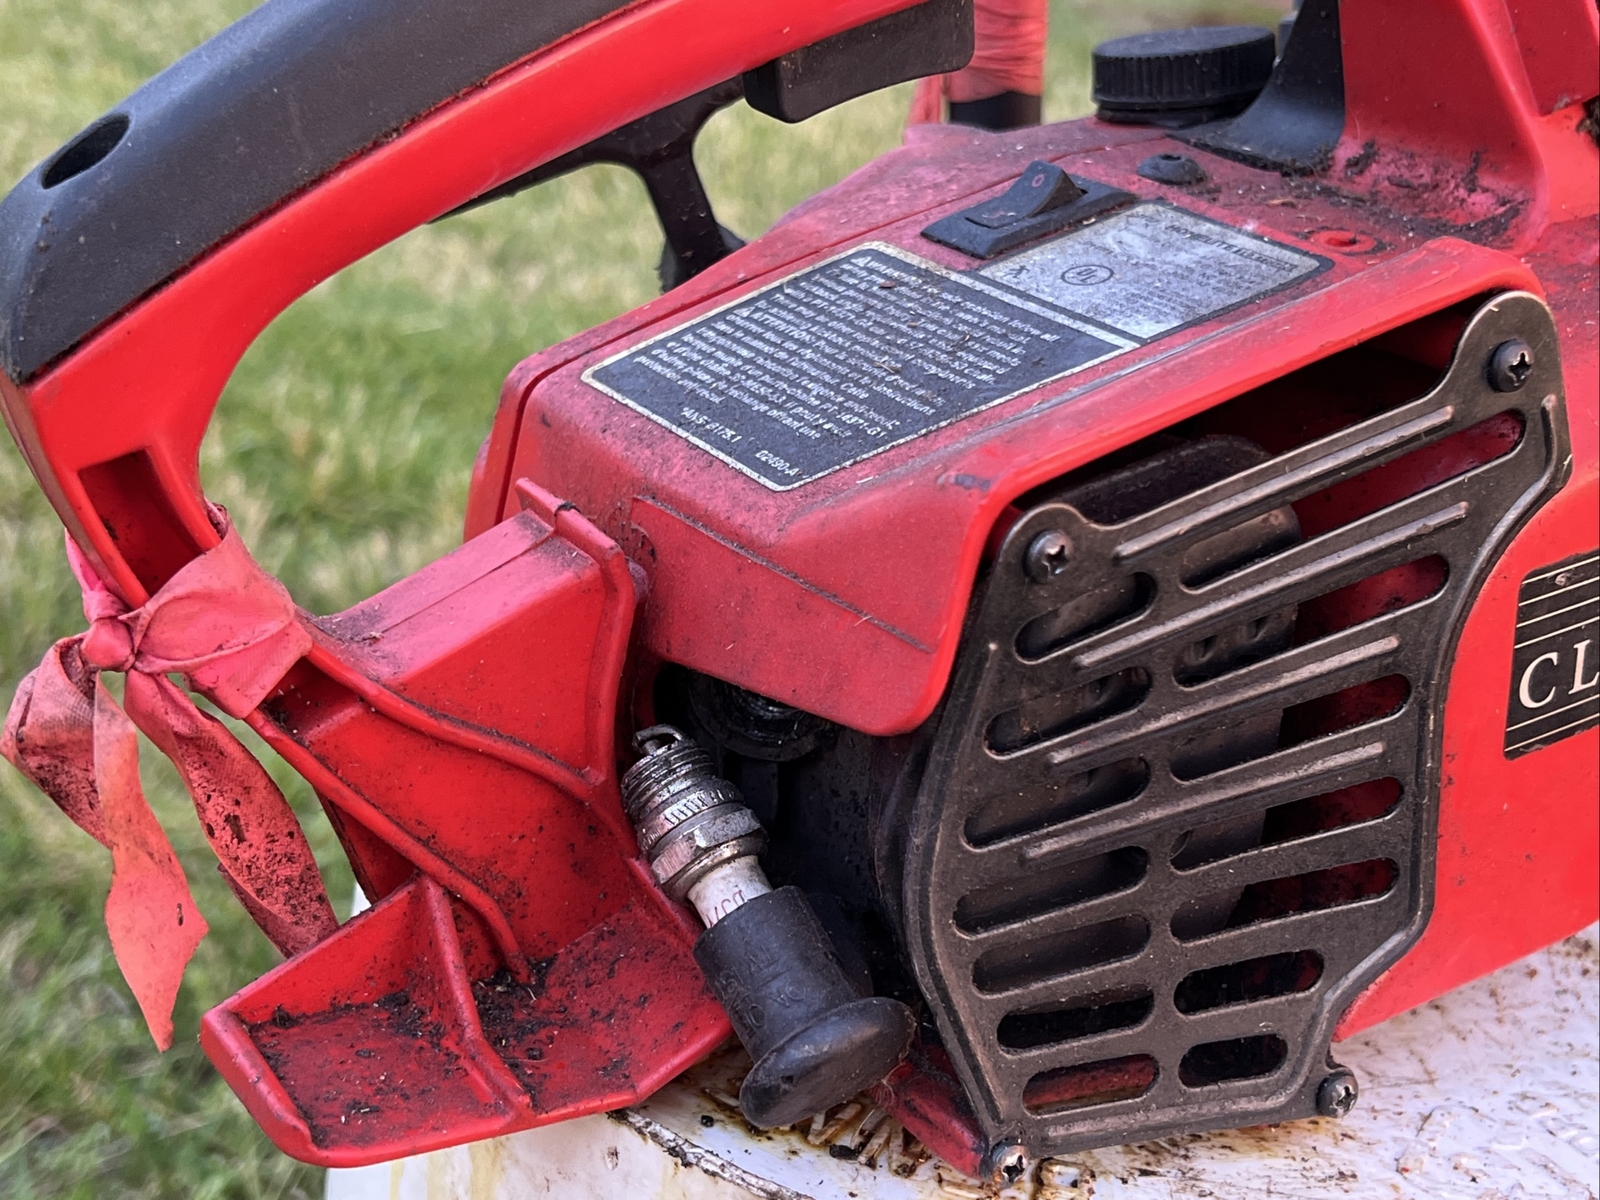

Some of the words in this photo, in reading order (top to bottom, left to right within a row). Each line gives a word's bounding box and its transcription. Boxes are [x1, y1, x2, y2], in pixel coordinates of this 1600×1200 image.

[987, 350, 1021, 366] meets
[840, 383, 869, 399] Cette
[756, 450, 799, 476] 02490-A
[1518, 638, 1600, 710] CL
